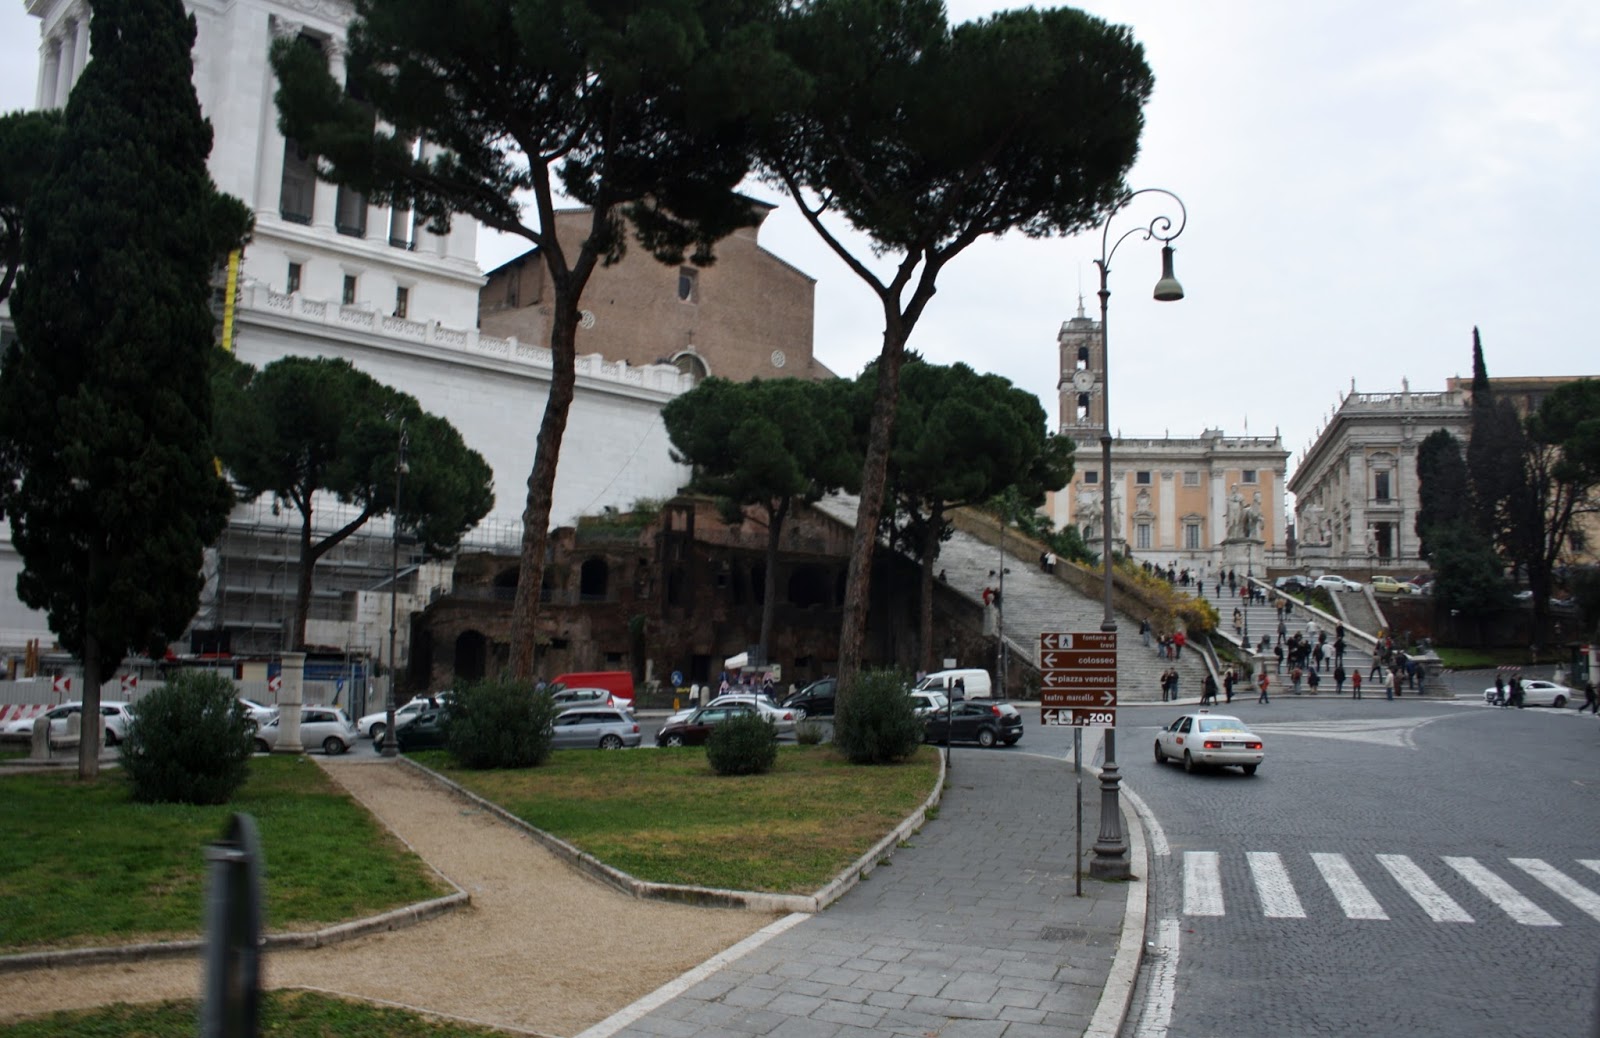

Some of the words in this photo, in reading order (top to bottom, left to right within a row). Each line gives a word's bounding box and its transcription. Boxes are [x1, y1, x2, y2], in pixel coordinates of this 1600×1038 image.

[1078, 656, 1115, 664] colosseo
[1058, 675, 1083, 684] piazza
[1084, 675, 1115, 683] venezia
